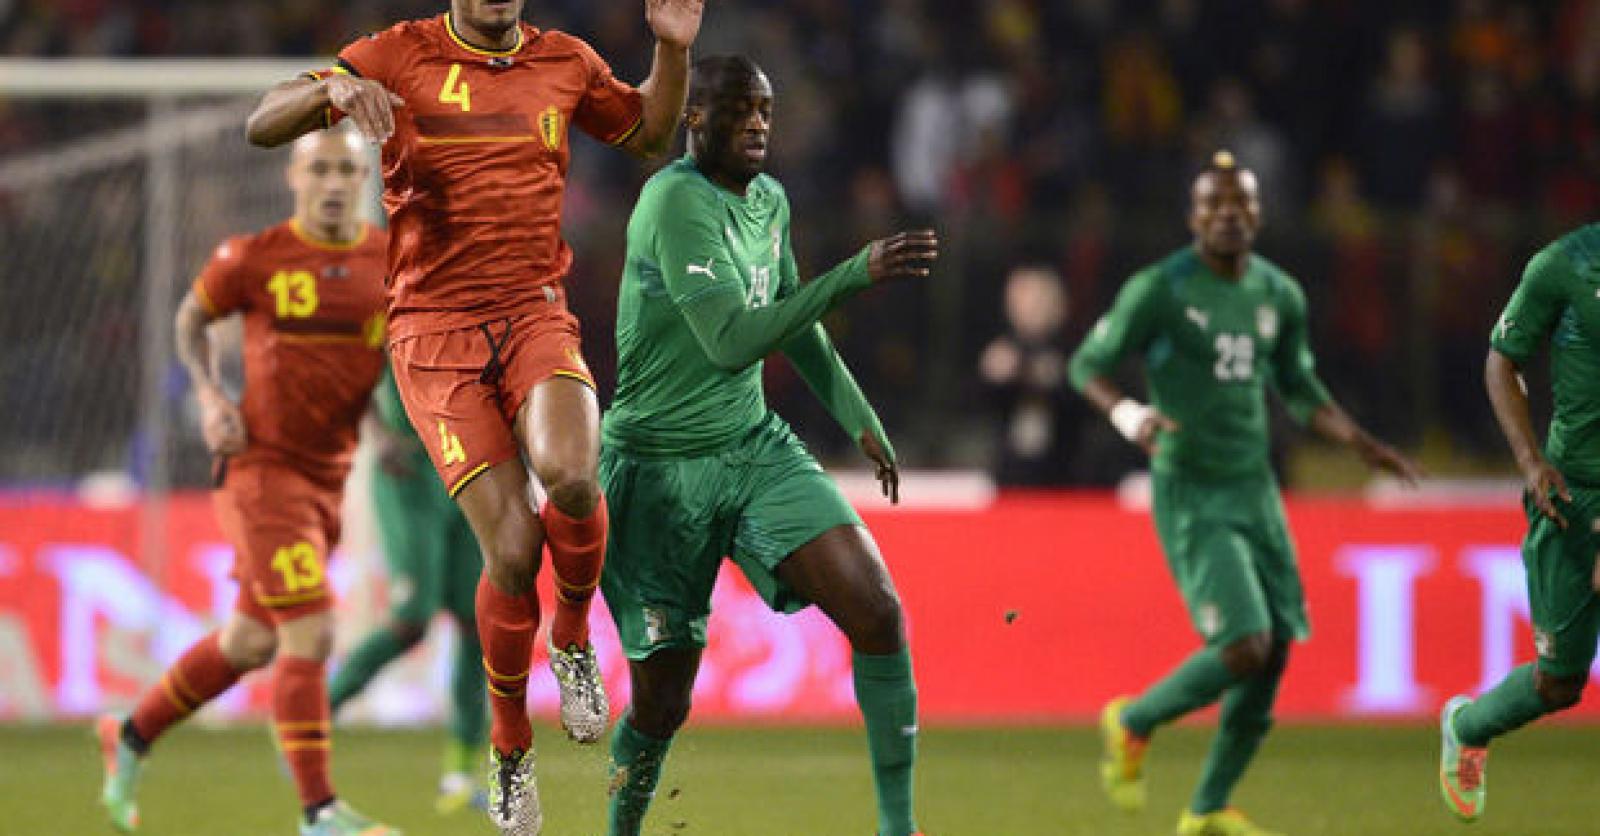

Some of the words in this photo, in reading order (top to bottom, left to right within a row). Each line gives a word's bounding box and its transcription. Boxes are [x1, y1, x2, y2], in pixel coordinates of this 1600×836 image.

[438, 63, 471, 112] 4
[266, 269, 318, 318] 13
[438, 420, 466, 465] 4
[271, 541, 321, 592] 13
